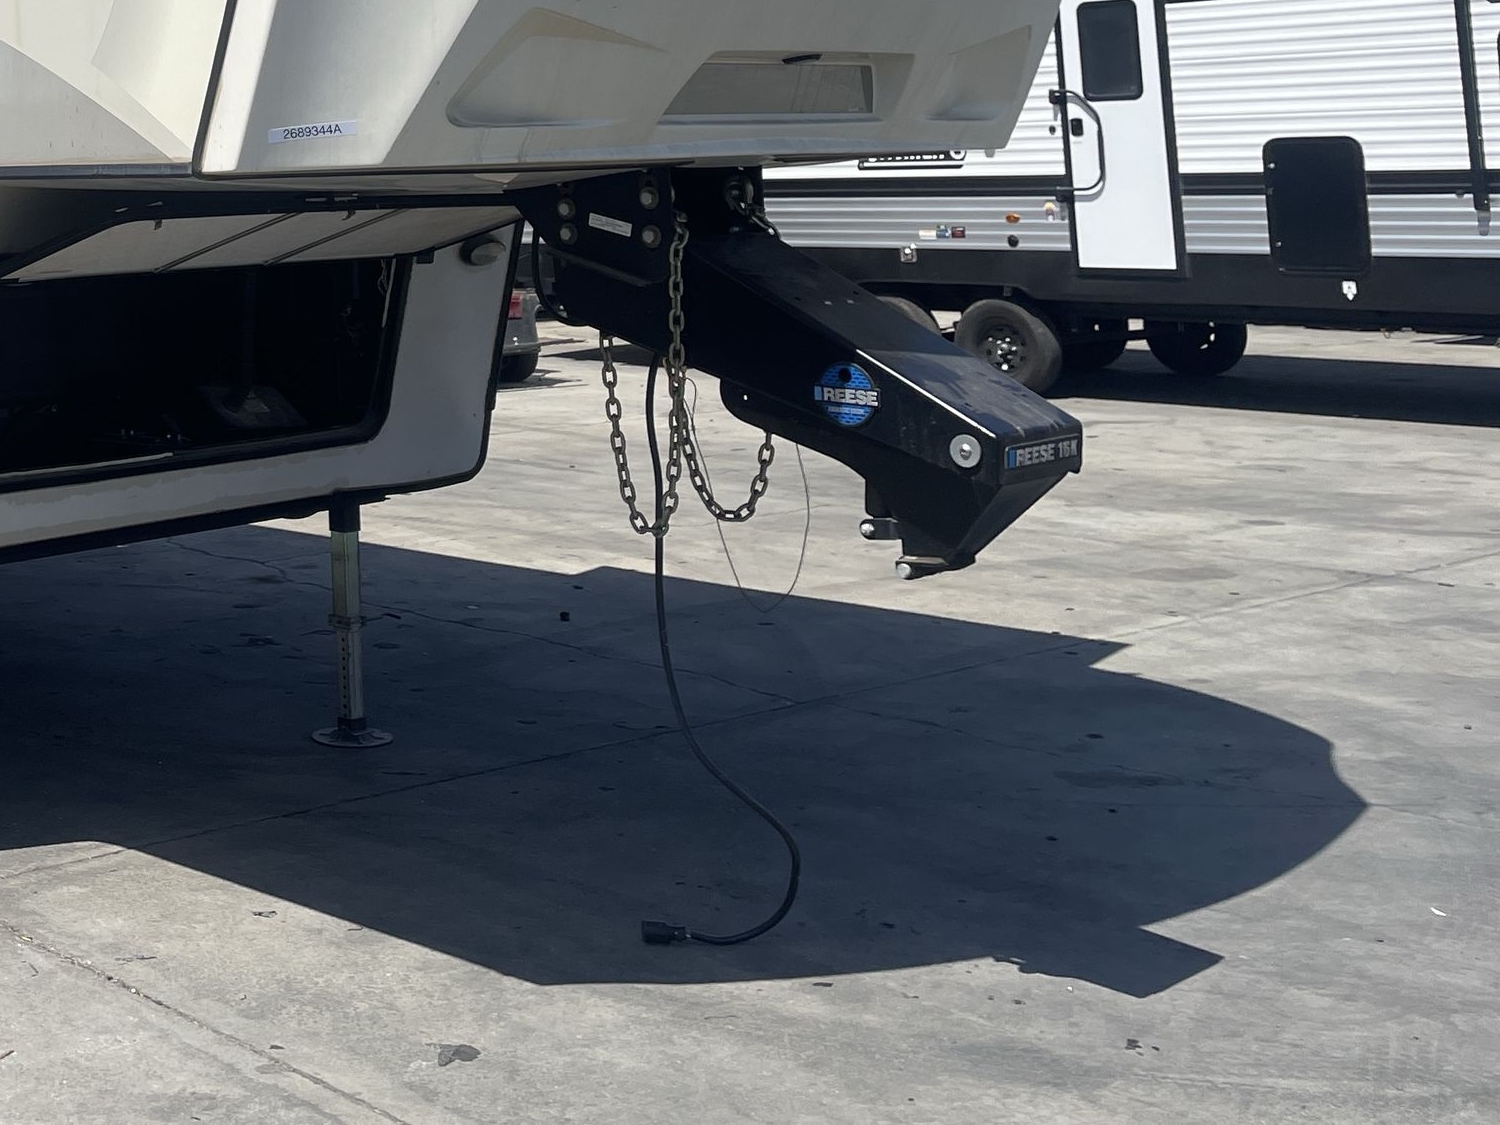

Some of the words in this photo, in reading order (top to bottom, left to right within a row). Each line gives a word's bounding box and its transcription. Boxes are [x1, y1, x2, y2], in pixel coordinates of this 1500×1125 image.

[283, 124, 342, 139] 2689344A
[823, 387, 879, 406] REESE
[1016, 443, 1056, 467] REESE
